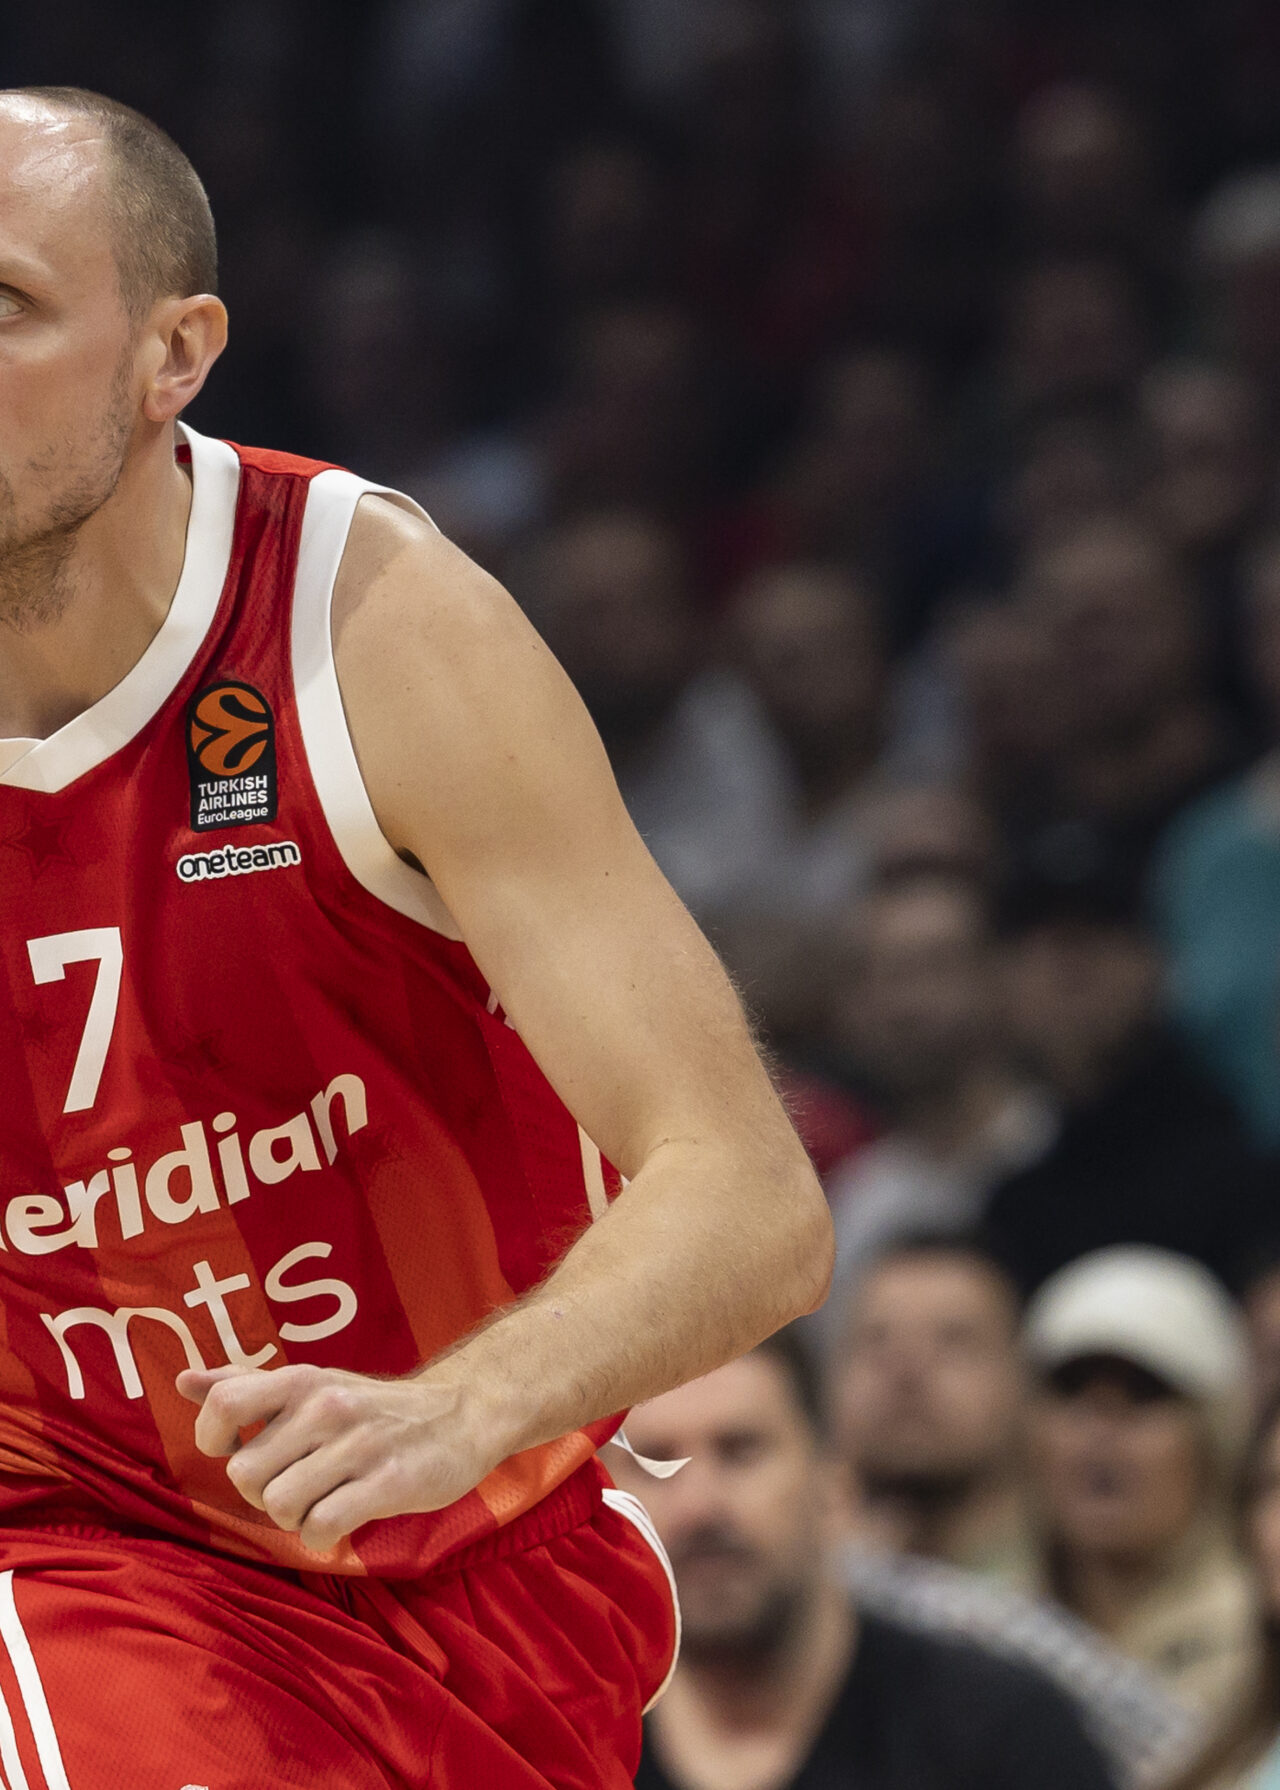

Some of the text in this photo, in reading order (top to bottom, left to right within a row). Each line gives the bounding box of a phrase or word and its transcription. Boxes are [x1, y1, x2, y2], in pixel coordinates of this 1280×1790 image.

[197, 775, 268, 797] TURKISH
[198, 790, 268, 812] AIRLINES
[197, 807, 269, 825] EuroLeague
[179, 843, 298, 878] oneteam
[26, 926, 124, 1114] 7
[39, 1241, 359, 1400] mts
